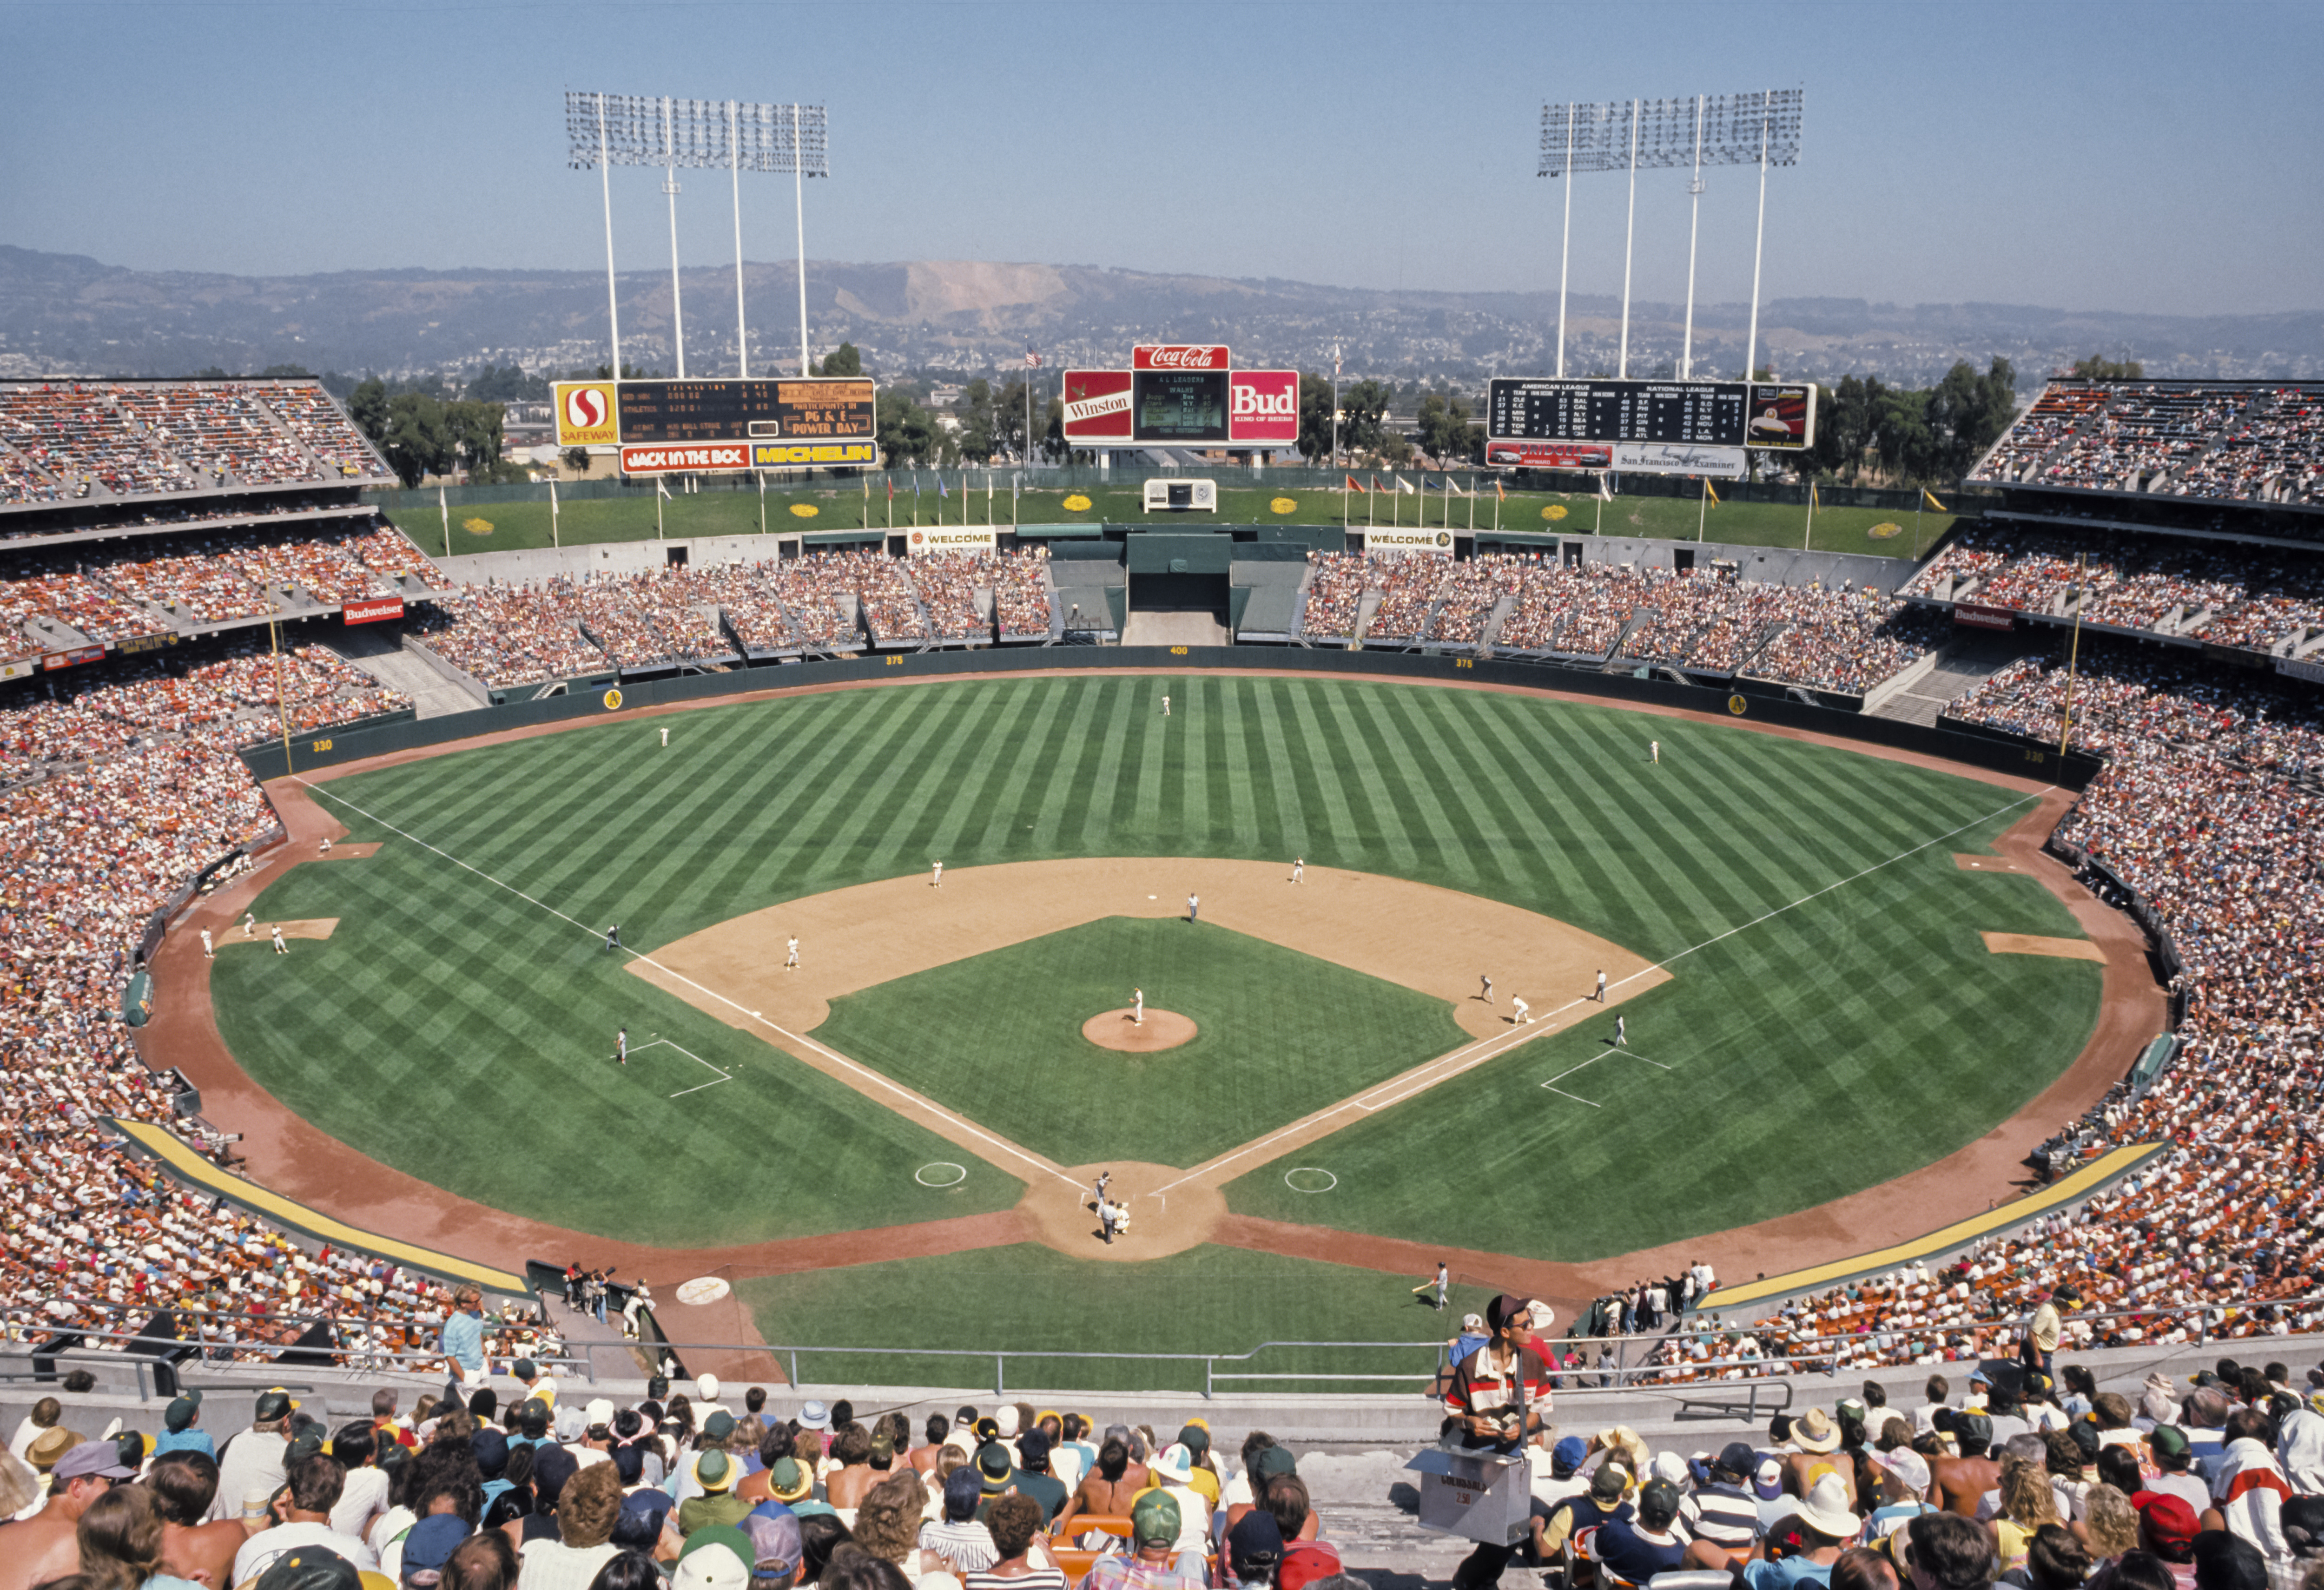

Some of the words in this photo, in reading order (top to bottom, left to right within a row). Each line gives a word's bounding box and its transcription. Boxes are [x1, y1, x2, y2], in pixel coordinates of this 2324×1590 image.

[1150, 347, 1215, 367] Coca-Cola
[1232, 385, 1295, 414] Bud
[1070, 398, 1128, 418] Winston
[805, 410, 820, 422] PG
[825, 410, 835, 422] &
[840, 410, 846, 422] E
[793, 422, 831, 434] POWER
[836, 422, 859, 434] DAY
[561, 430, 615, 441] SAFEWAY
[756, 445, 872, 463] MICHELIN
[1519, 444, 1583, 456] BRIDGES
[628, 452, 667, 467] JACK
[685, 450, 710, 464] THE
[711, 449, 741, 464] BOX
[1621, 455, 1638, 465] San
[1638, 455, 1679, 467] Francisco
[1693, 456, 1736, 469] Examiner
[928, 534, 992, 543] WELCOME
[1370, 535, 1433, 544] WELCOME
[345, 605, 403, 620] Budweiser
[1955, 609, 2012, 626] Budweiser
[1170, 646, 1188, 655] 400
[886, 655, 903, 665] 375
[1456, 658, 1472, 668] 375
[313, 739, 332, 752] 330
[2025, 750, 2043, 763] 330
[1456, 1492, 1470, 1504] 2.50
